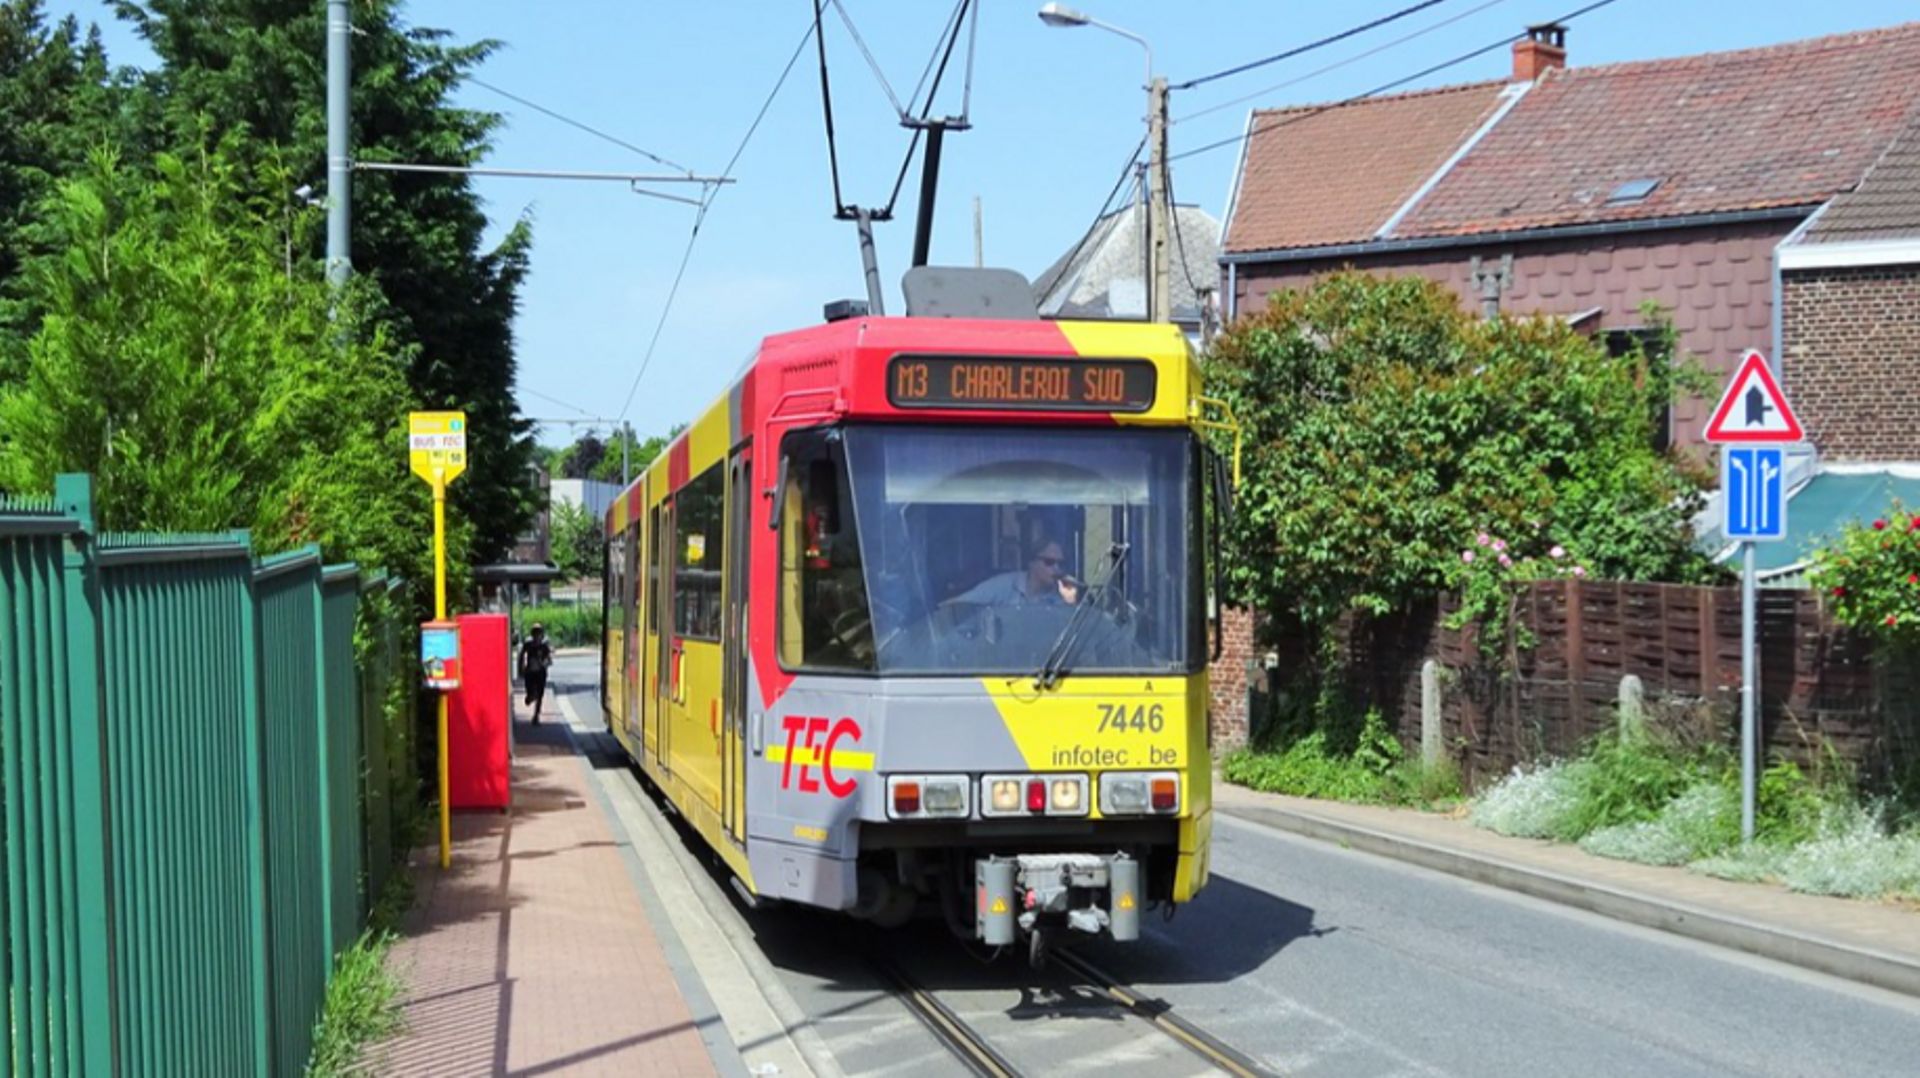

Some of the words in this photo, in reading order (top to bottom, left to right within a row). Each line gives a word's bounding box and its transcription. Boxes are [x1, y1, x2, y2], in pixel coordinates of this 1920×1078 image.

[898, 364, 928, 398] M3
[951, 366, 1070, 400] CHARLEROI
[1084, 368, 1124, 401] SUD
[1145, 680, 1153, 691] A
[1096, 704, 1164, 733] 7446
[781, 715, 862, 798] TEC
[1052, 745, 1128, 766] infotec
[1150, 744, 1177, 765] be
